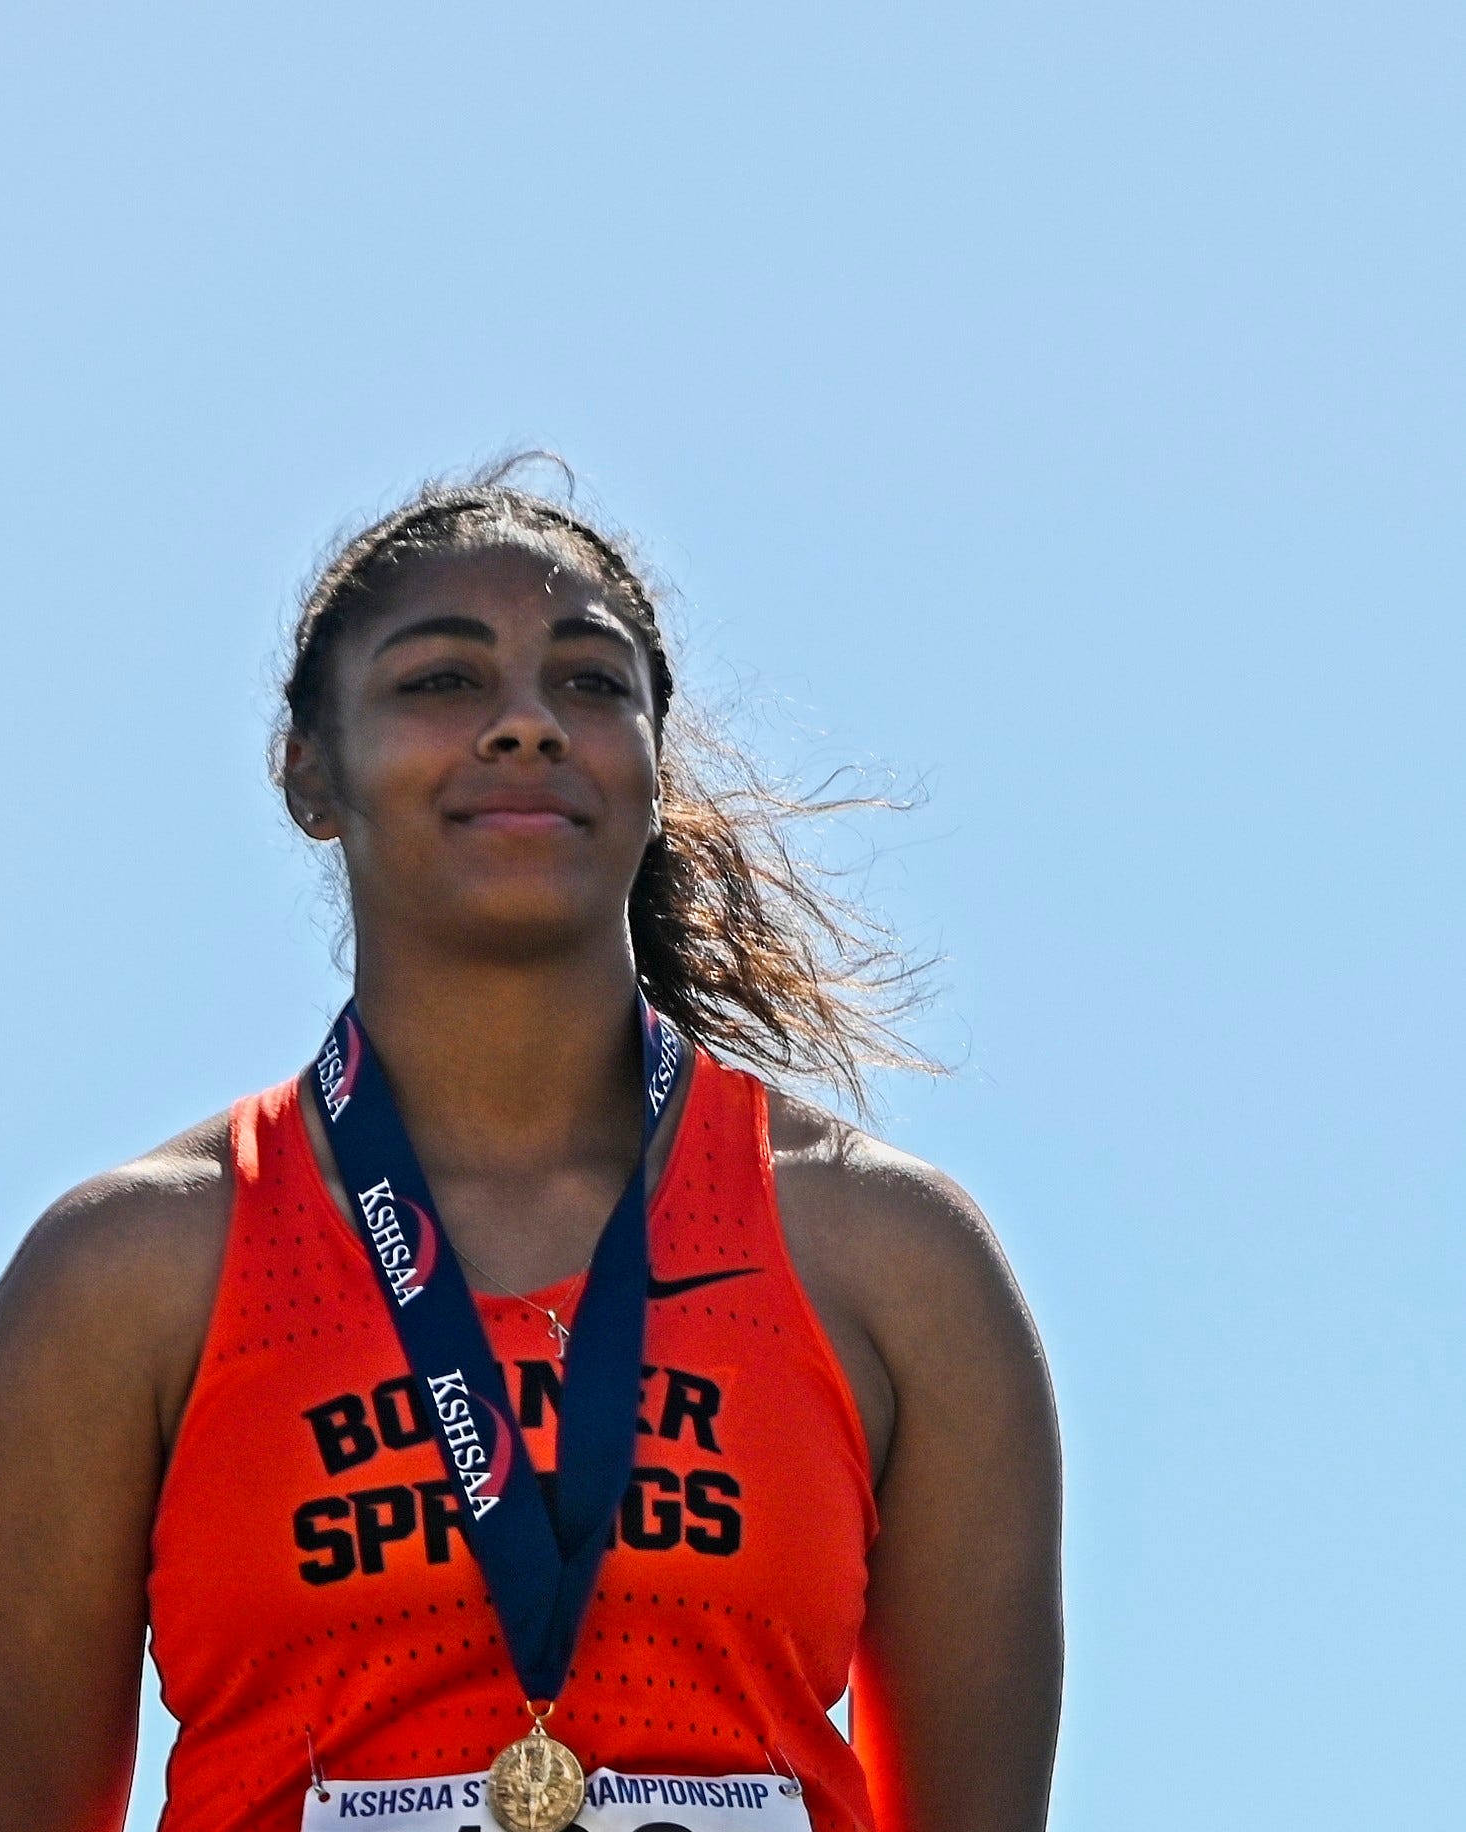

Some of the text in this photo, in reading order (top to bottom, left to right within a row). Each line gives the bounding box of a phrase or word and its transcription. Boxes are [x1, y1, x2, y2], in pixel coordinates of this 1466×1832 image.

[317, 1035, 352, 1123] HSAA
[358, 1177, 426, 1307] KSHSAA
[301, 1359, 723, 1476] BONR
[428, 1368, 500, 1521] KSHSAA
[293, 1467, 742, 1587] SPRGS
[339, 1782, 453, 1817] KSHSAA
[584, 1774, 769, 1809] HAMPIONSHIP
